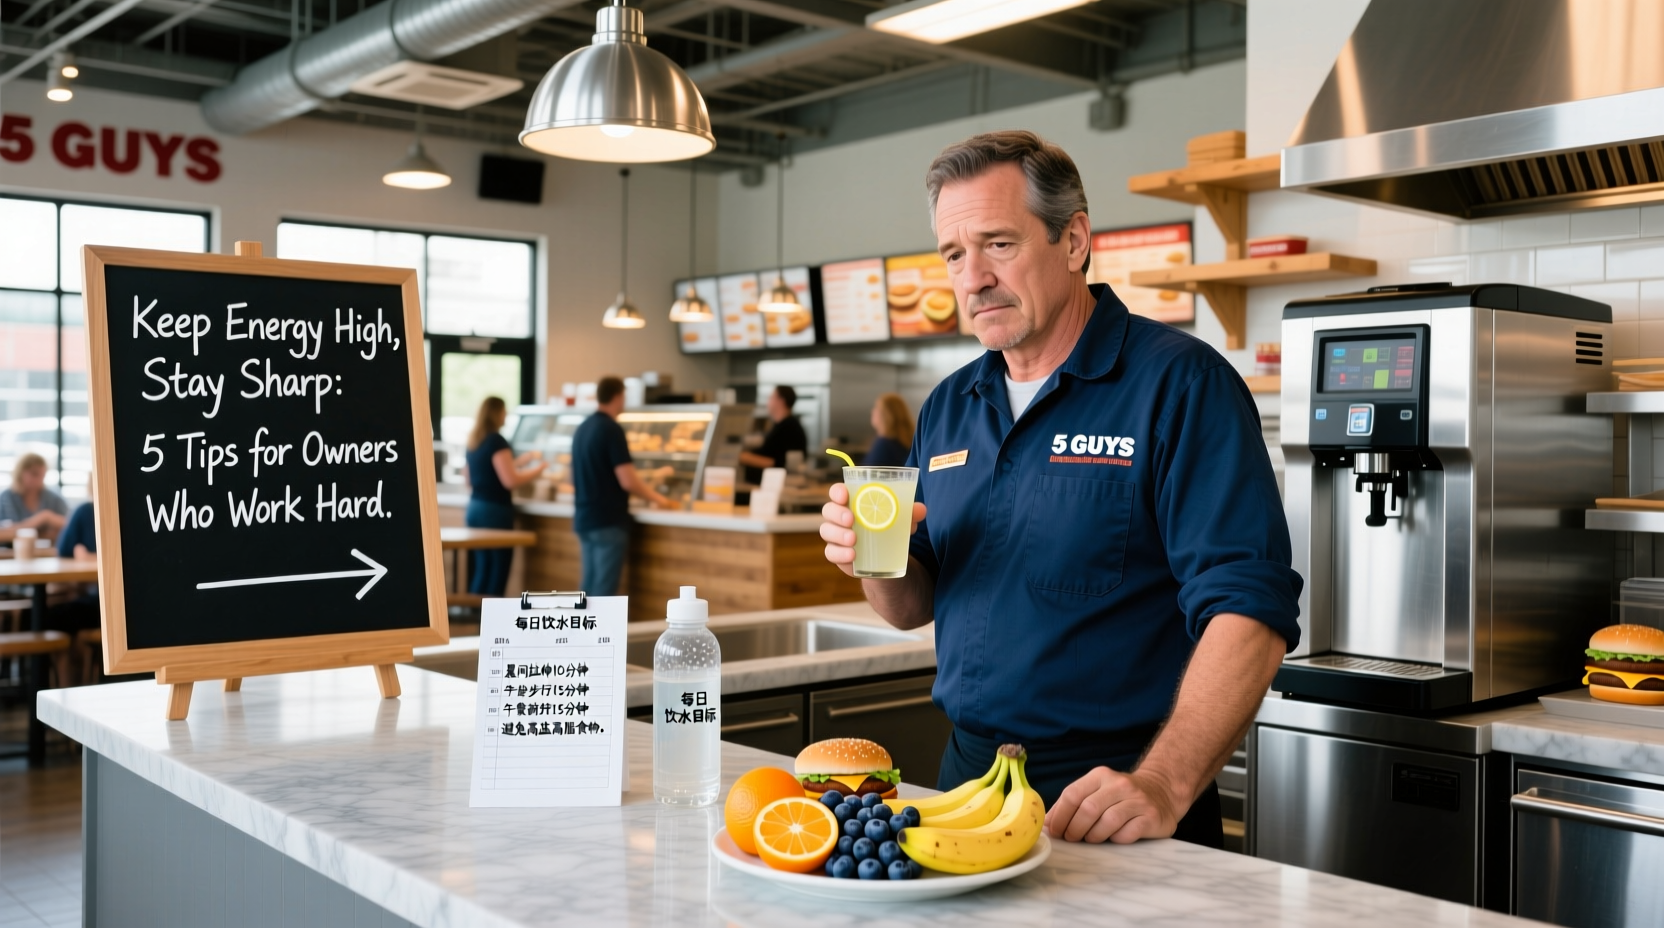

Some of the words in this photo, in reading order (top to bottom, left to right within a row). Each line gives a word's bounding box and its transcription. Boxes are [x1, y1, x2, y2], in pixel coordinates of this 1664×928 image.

[0, 114, 35, 163] 5
[51, 119, 223, 184] GUYS
[133, 295, 211, 356] Keep
[227, 303, 322, 360] Energy
[336, 308, 400, 360] High,
[142, 357, 224, 418] Stay
[241, 357, 342, 414] Sharp:
[141, 434, 165, 472] 5
[177, 432, 238, 485] Tips
[249, 427, 292, 477] for
[303, 431, 398, 466] Owners
[1051, 434, 1067, 454] 5
[1071, 434, 1135, 457] GUYS
[146, 489, 213, 532] Who
[228, 485, 304, 527] Work
[316, 480, 391, 521] Hard.
[515, 615, 596, 630] 每日饮水目标
[665, 708, 716, 724] 饮水目标
[681, 692, 707, 706] 每日
